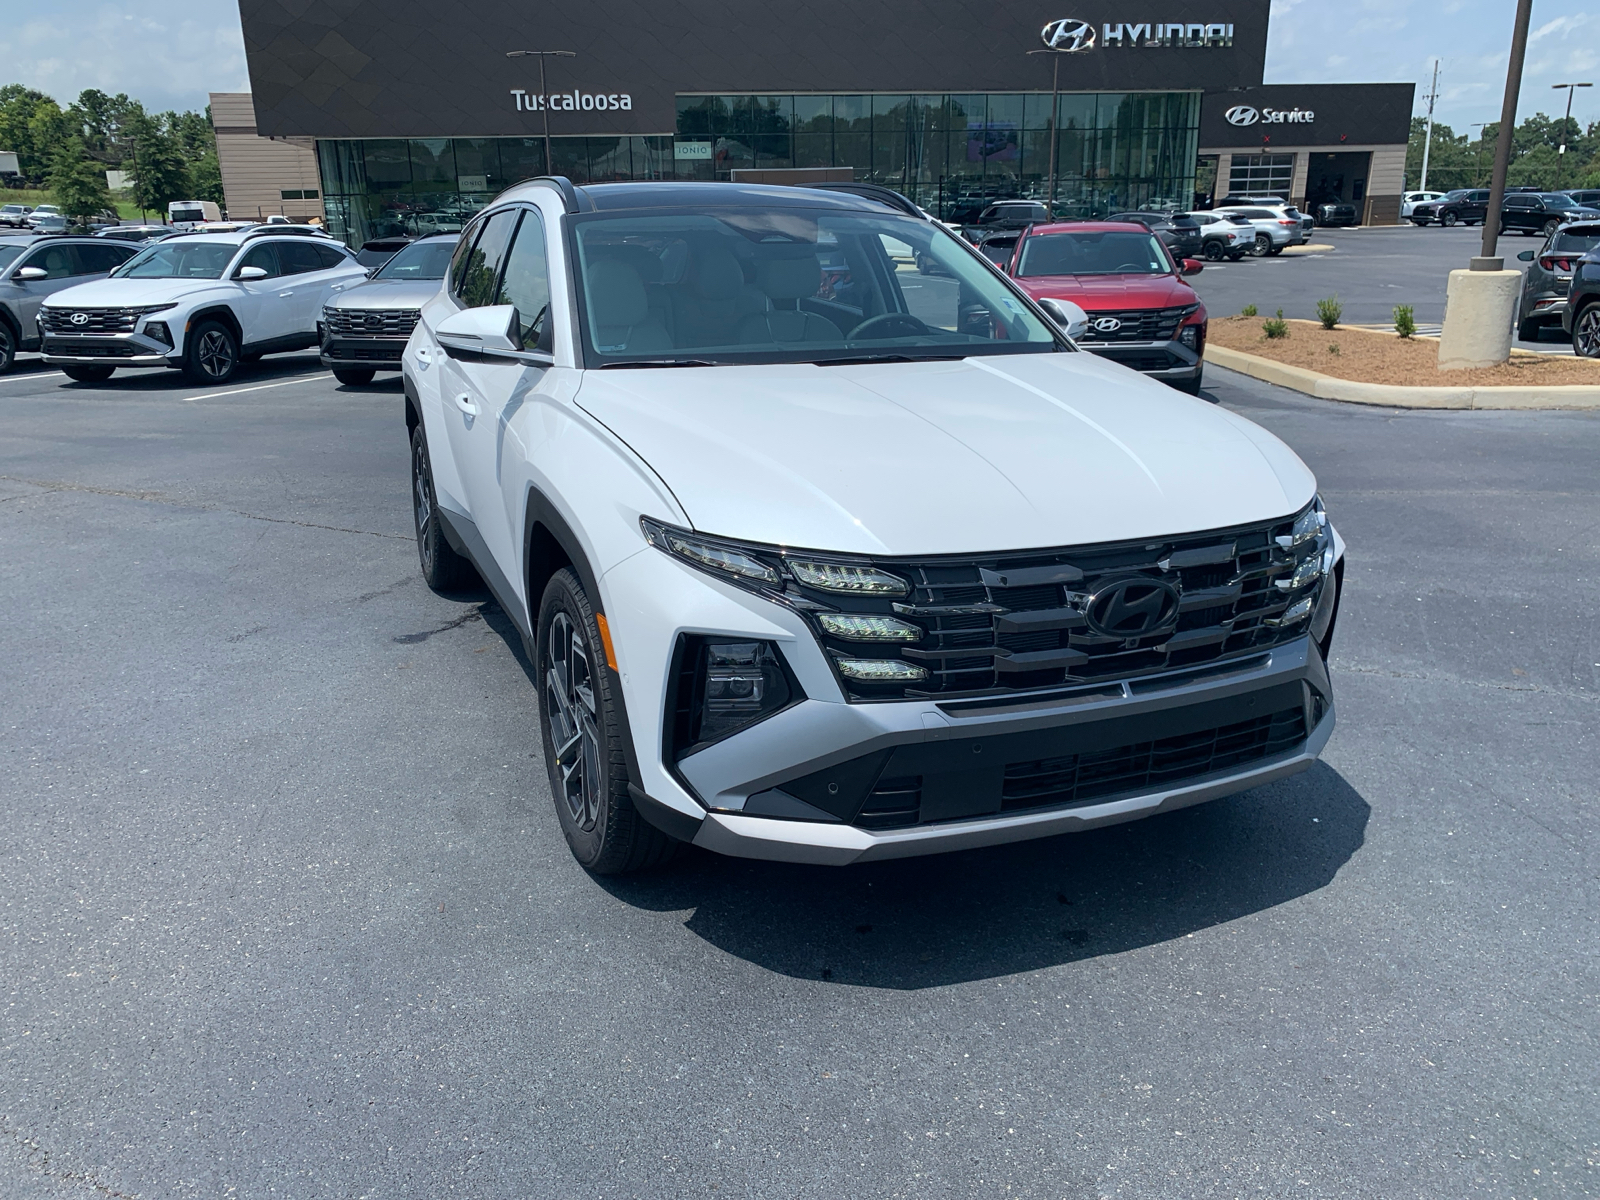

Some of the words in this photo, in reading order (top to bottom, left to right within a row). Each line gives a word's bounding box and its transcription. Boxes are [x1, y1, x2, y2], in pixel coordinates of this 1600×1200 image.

[1102, 23, 1234, 48] HYUNDAI
[510, 89, 632, 111] Tuscaloosa
[1261, 107, 1315, 123] Service
